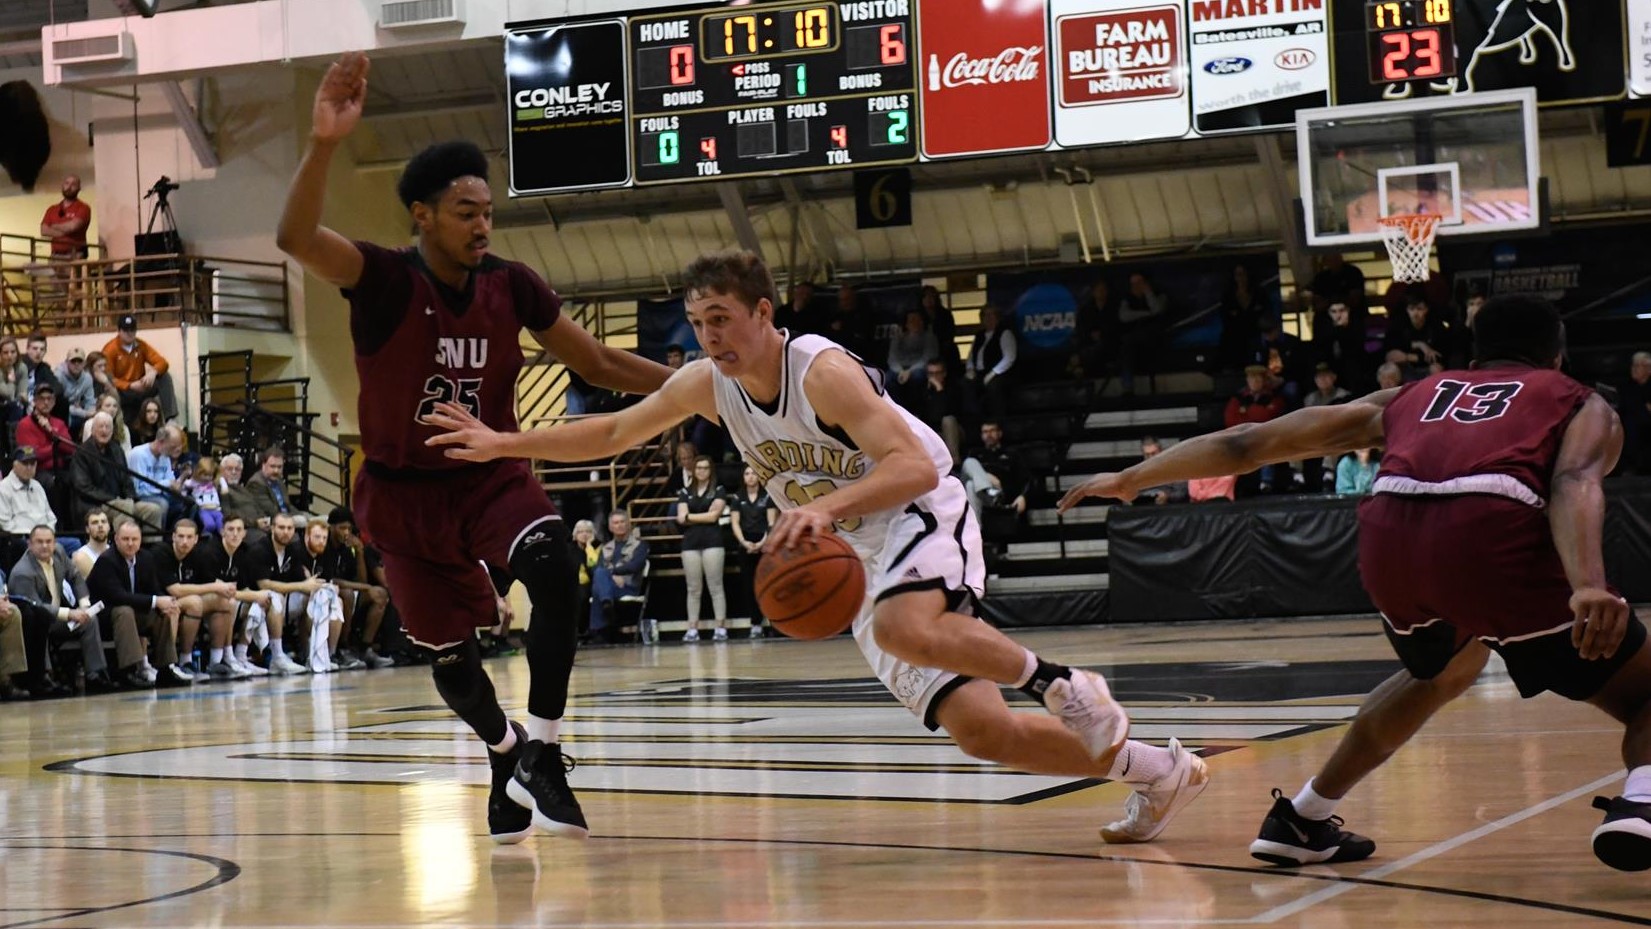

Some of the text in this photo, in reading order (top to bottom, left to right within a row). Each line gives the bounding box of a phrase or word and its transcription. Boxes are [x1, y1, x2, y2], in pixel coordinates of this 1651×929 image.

[840, 0, 909, 22] VISITOR
[640, 20, 690, 42] HOME
[724, 8, 829, 56] 17:10
[1096, 19, 1169, 48] FARM
[1295, 22, 1321, 36] AR
[880, 25, 906, 66] 6
[1382, 30, 1441, 79] 23
[670, 45, 695, 85] 0
[744, 62, 770, 74] POSS
[942, 45, 1044, 89] Coca-Cola
[1068, 43, 1171, 74] BUREAU
[1210, 58, 1246, 73] Ford
[1281, 53, 1310, 66] KIA
[735, 73, 781, 90] PERIOD
[796, 66, 806, 95] 1
[839, 74, 882, 90] BONUS
[1088, 73, 1172, 95] INSURANCE
[514, 82, 611, 108] CONLEY
[663, 90, 704, 106] BONUS
[868, 95, 909, 111] FOULS
[544, 100, 623, 119] GRAPHICS
[728, 108, 775, 124] PLAYER
[787, 103, 827, 118] FOULS
[640, 117, 680, 132] FOULS
[887, 111, 909, 143] 2
[1621, 108, 1650, 159] 7
[659, 132, 679, 164] 0
[831, 126, 847, 148] 4
[701, 138, 716, 159] 4
[826, 150, 852, 165] TOL
[697, 161, 721, 175] TOL
[870, 174, 897, 222] 6
[1022, 312, 1077, 332] NCAA
[435, 337, 488, 369] SNU
[414, 374, 483, 426] 25
[1420, 379, 1524, 424] 13
[745, 438, 865, 486] ARDING
